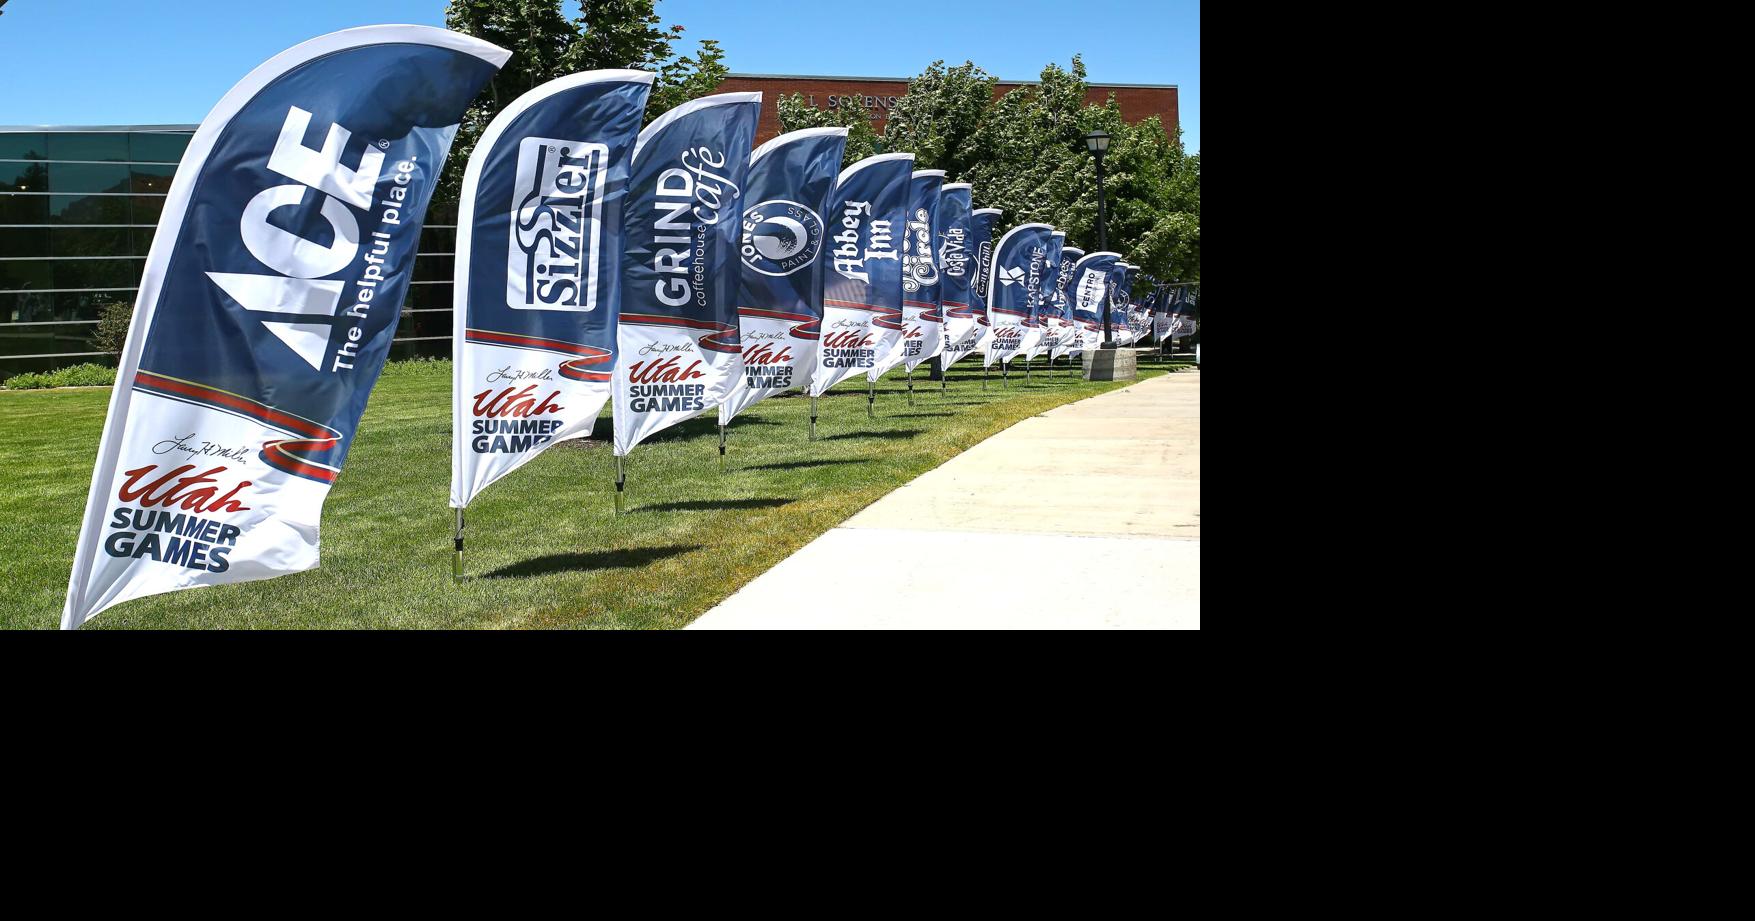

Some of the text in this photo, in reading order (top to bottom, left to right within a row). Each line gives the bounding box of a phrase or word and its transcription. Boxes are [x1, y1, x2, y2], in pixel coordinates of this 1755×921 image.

[204, 105, 386, 371] ACE
[536, 146, 591, 307] Sizzler
[654, 168, 694, 307] GRIND
[681, 146, 740, 307] coffeehouse café
[741, 211, 763, 263] JONES
[788, 207, 820, 238] GLASS
[864, 219, 899, 261] Inn
[782, 248, 815, 270] PAINT
[832, 200, 872, 284] Abbey
[332, 155, 417, 373] The helpful place.
[1027, 246, 1044, 308] KAPSTONE
[1081, 272, 1096, 308] CENTRO
[823, 330, 875, 349] Utah
[823, 348, 875, 357] SUMMER
[629, 355, 706, 385] Utah
[745, 366, 794, 376] MMER
[823, 357, 875, 368] GAMES
[472, 384, 565, 418] Utah
[629, 384, 705, 398] SUMMER
[745, 376, 792, 389] AMES
[630, 396, 705, 413] GAMES
[118, 464, 253, 513] Utah
[110, 507, 241, 546] SUMMER
[104, 531, 232, 573] GAMES
